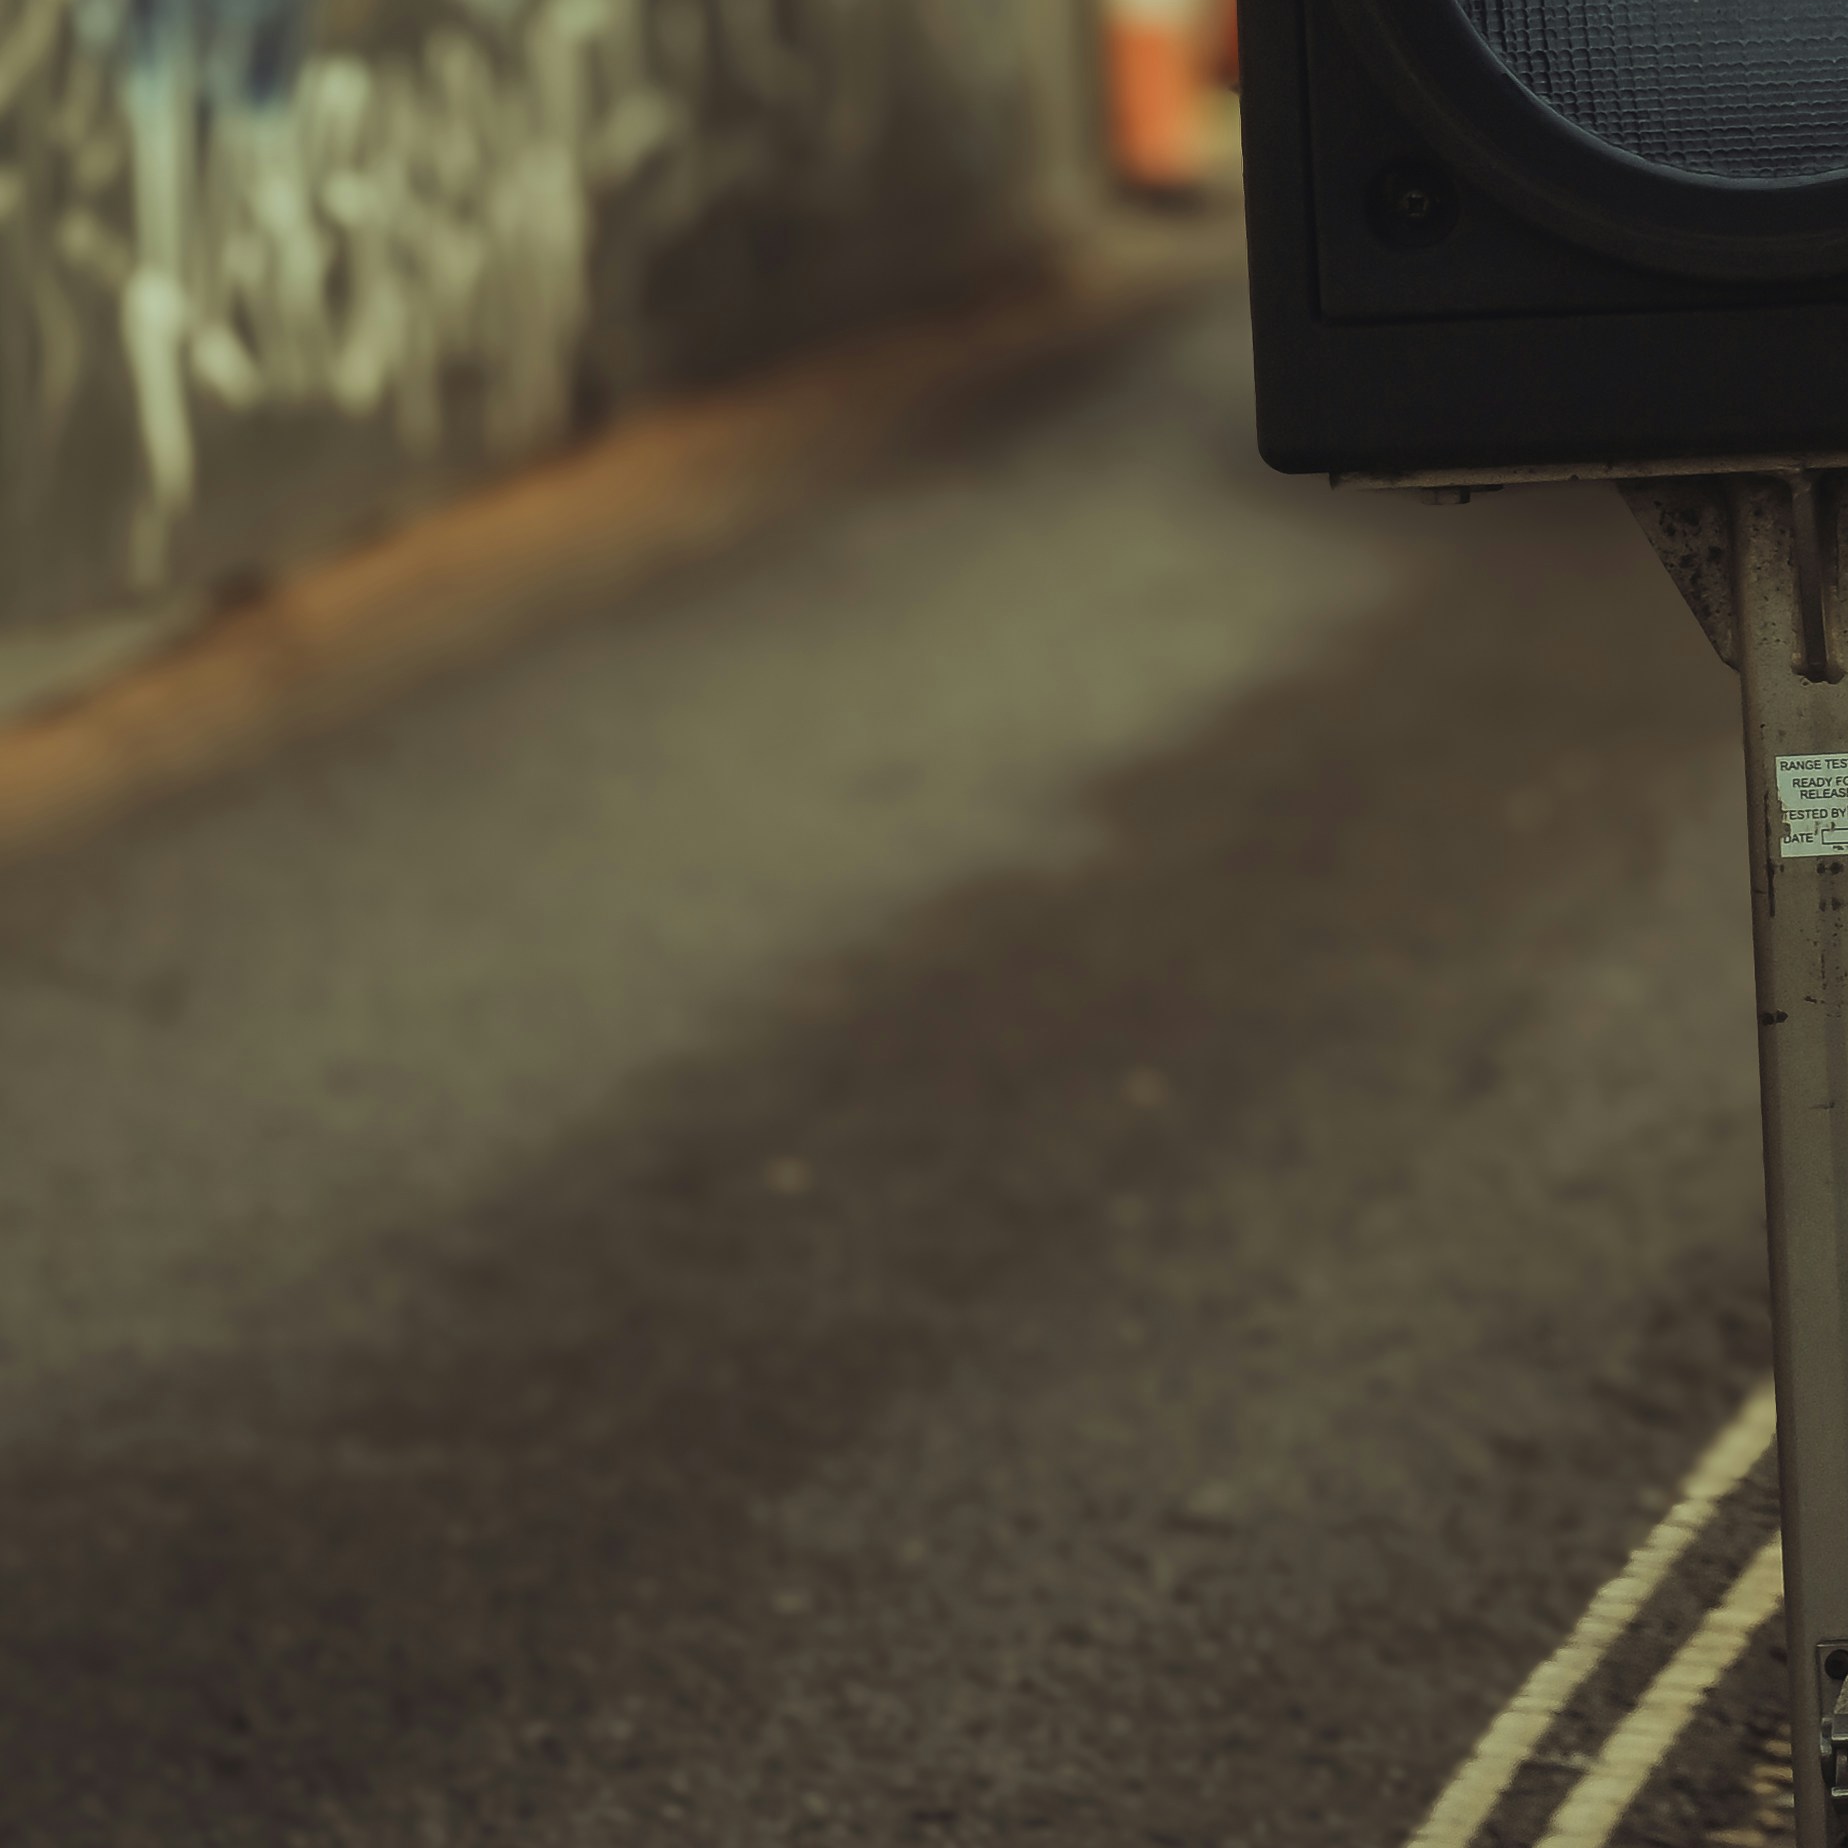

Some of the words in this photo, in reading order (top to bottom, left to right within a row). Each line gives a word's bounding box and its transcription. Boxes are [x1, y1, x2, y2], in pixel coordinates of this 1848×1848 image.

[1780, 760, 1822, 771] RANGE
[1792, 777, 1832, 788] READY
[1831, 808, 1846, 818] BY
[1783, 833, 1814, 844] DATE
